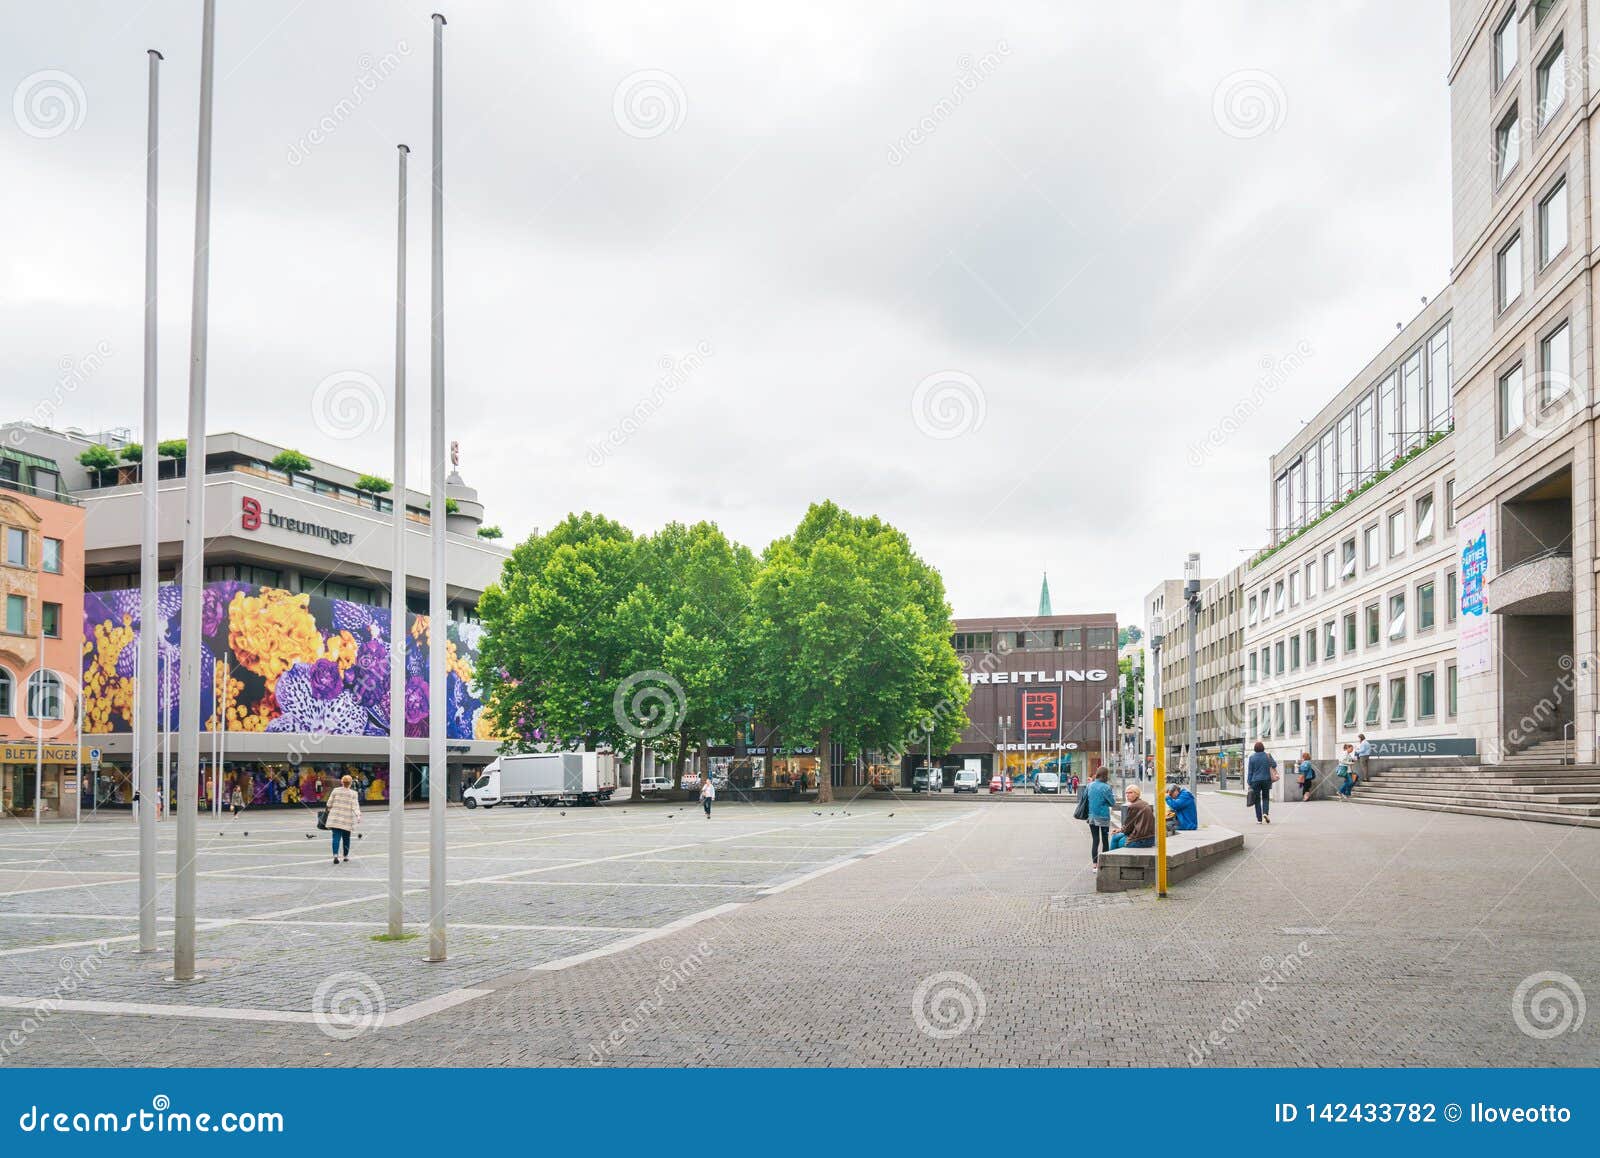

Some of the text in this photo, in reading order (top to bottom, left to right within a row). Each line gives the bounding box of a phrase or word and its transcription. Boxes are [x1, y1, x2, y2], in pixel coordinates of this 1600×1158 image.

[268, 508, 357, 546] breuninger
[1026, 695, 1054, 703] BIG
[997, 742, 1079, 752] BREITLING
[1370, 742, 1437, 753] RATHAUS
